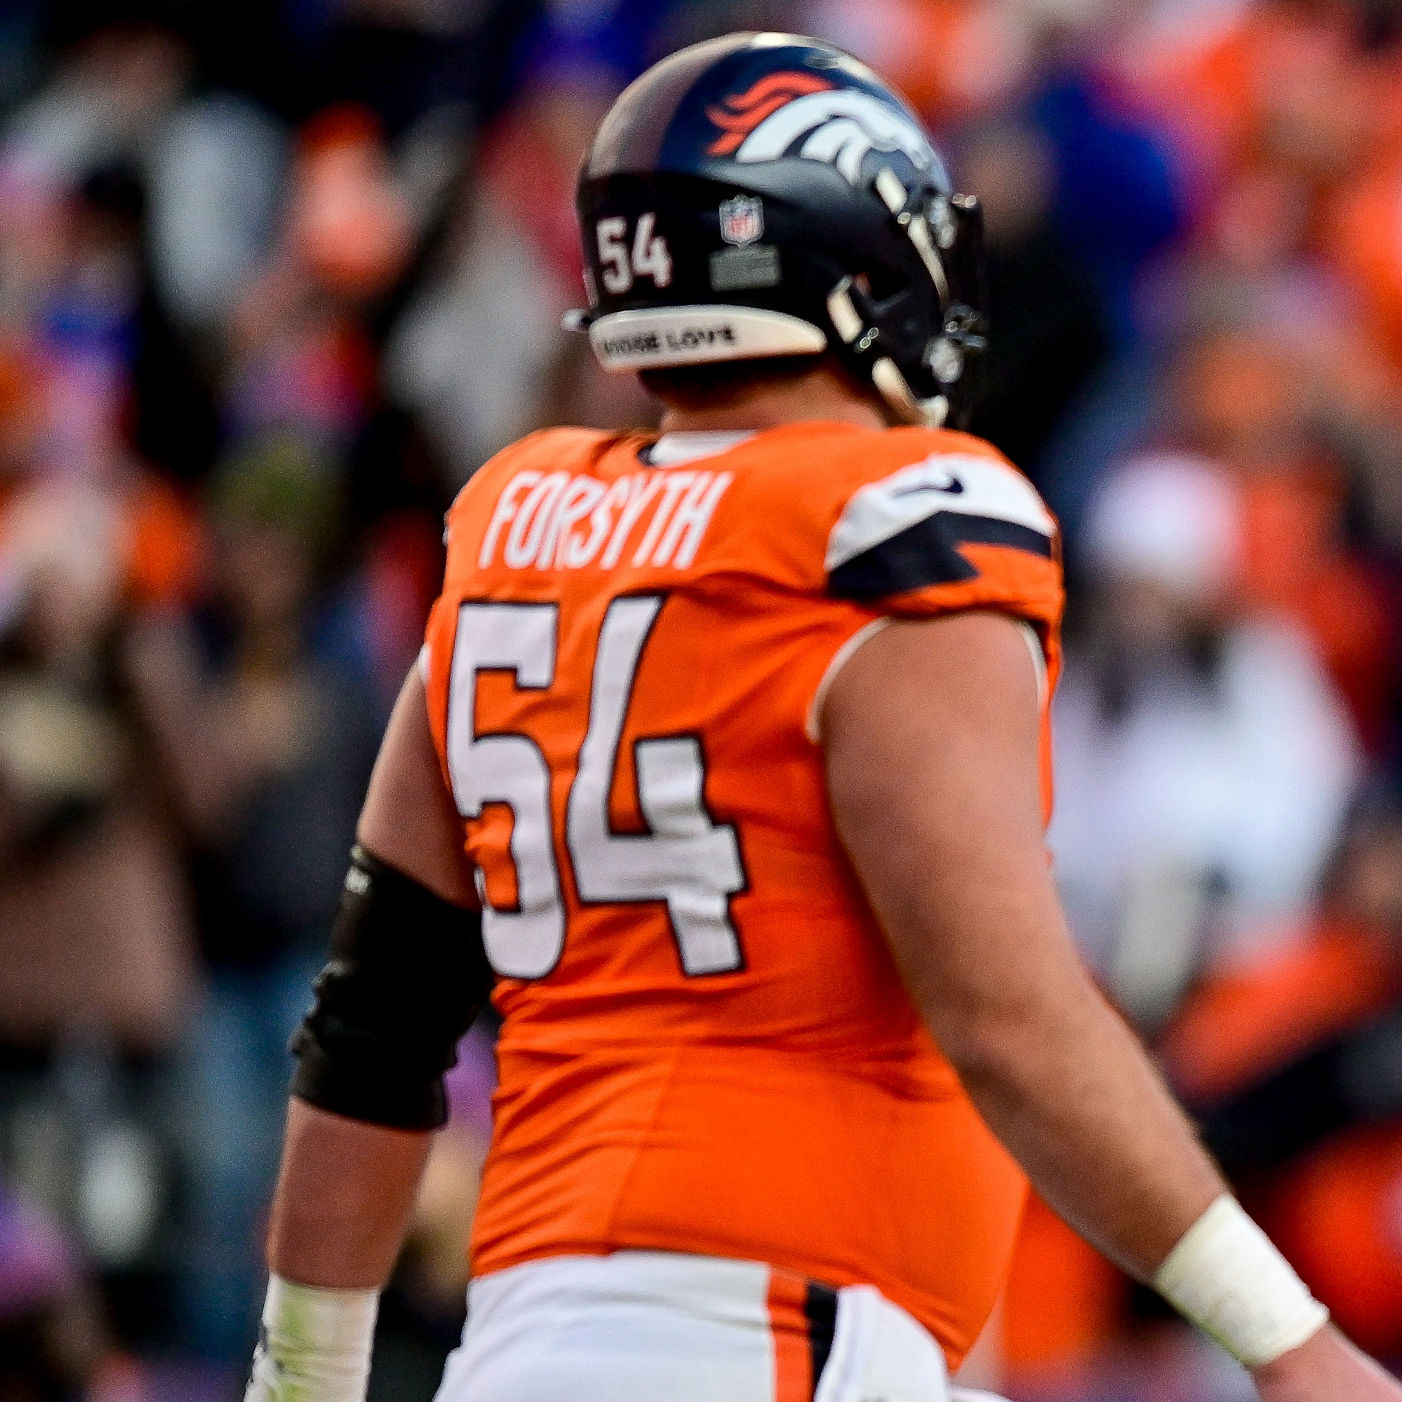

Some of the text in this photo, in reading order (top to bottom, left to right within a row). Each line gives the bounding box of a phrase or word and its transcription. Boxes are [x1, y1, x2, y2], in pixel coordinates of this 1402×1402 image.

[596, 211, 673, 294] 54
[478, 471, 735, 571] FORSYTH
[446, 594, 748, 980] 54
